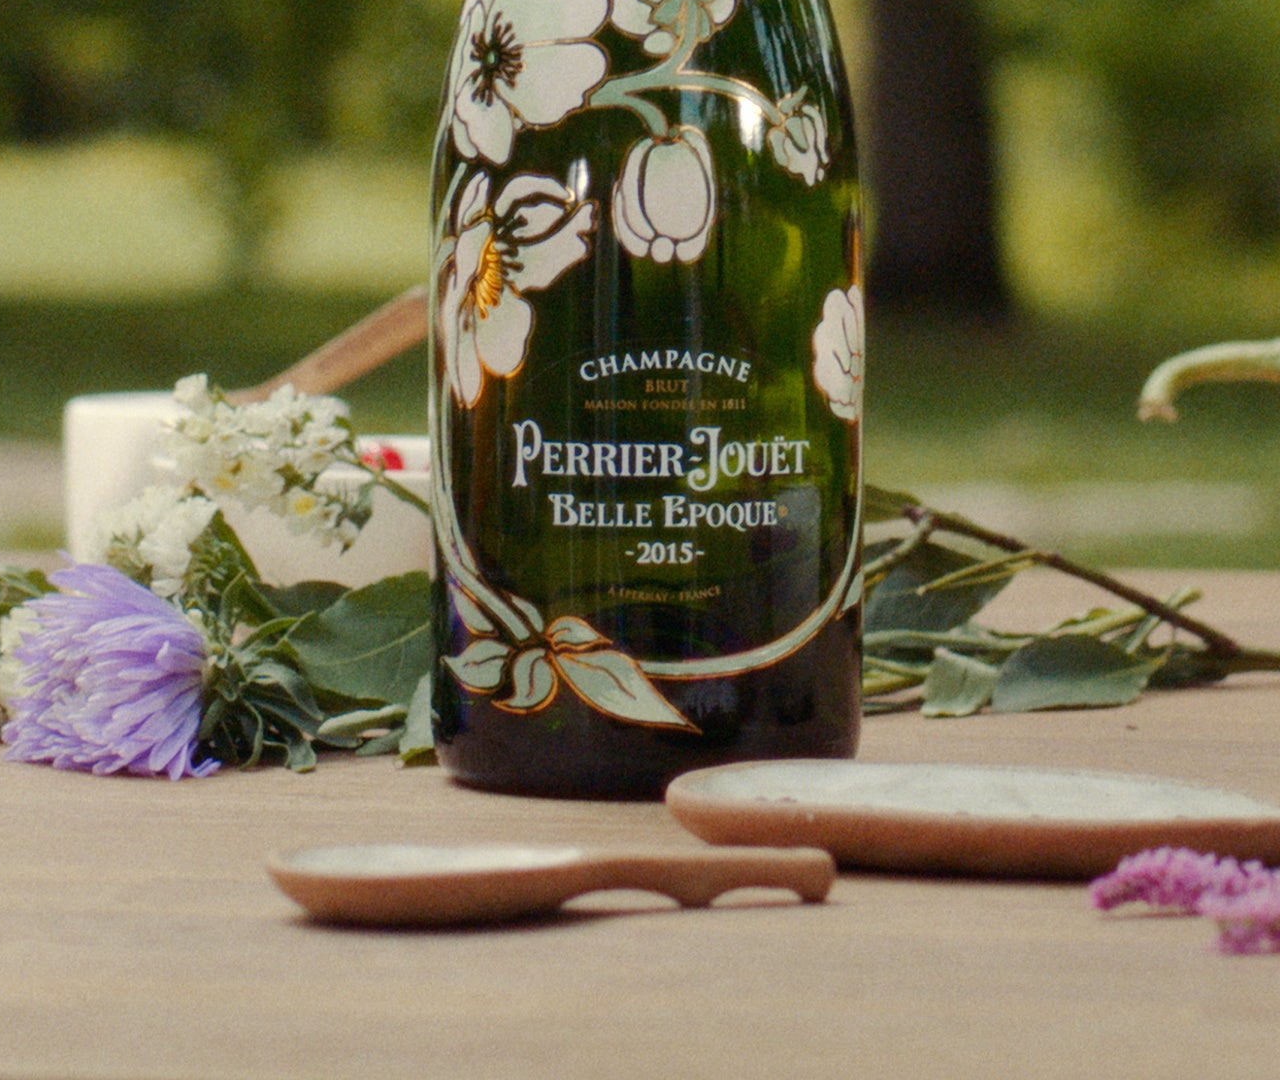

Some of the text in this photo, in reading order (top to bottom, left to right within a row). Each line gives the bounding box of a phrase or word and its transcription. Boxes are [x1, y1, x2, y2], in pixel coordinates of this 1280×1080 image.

[579, 349, 751, 383] CHAMPAGNE
[645, 379, 690, 393] BRUT
[584, 399, 637, 410] MAISON
[700, 399, 718, 410] EN
[722, 398, 746, 410] 1811
[512, 420, 810, 491] PERRIER-JOUËT
[548, 493, 778, 532] BELLE EPOQUE
